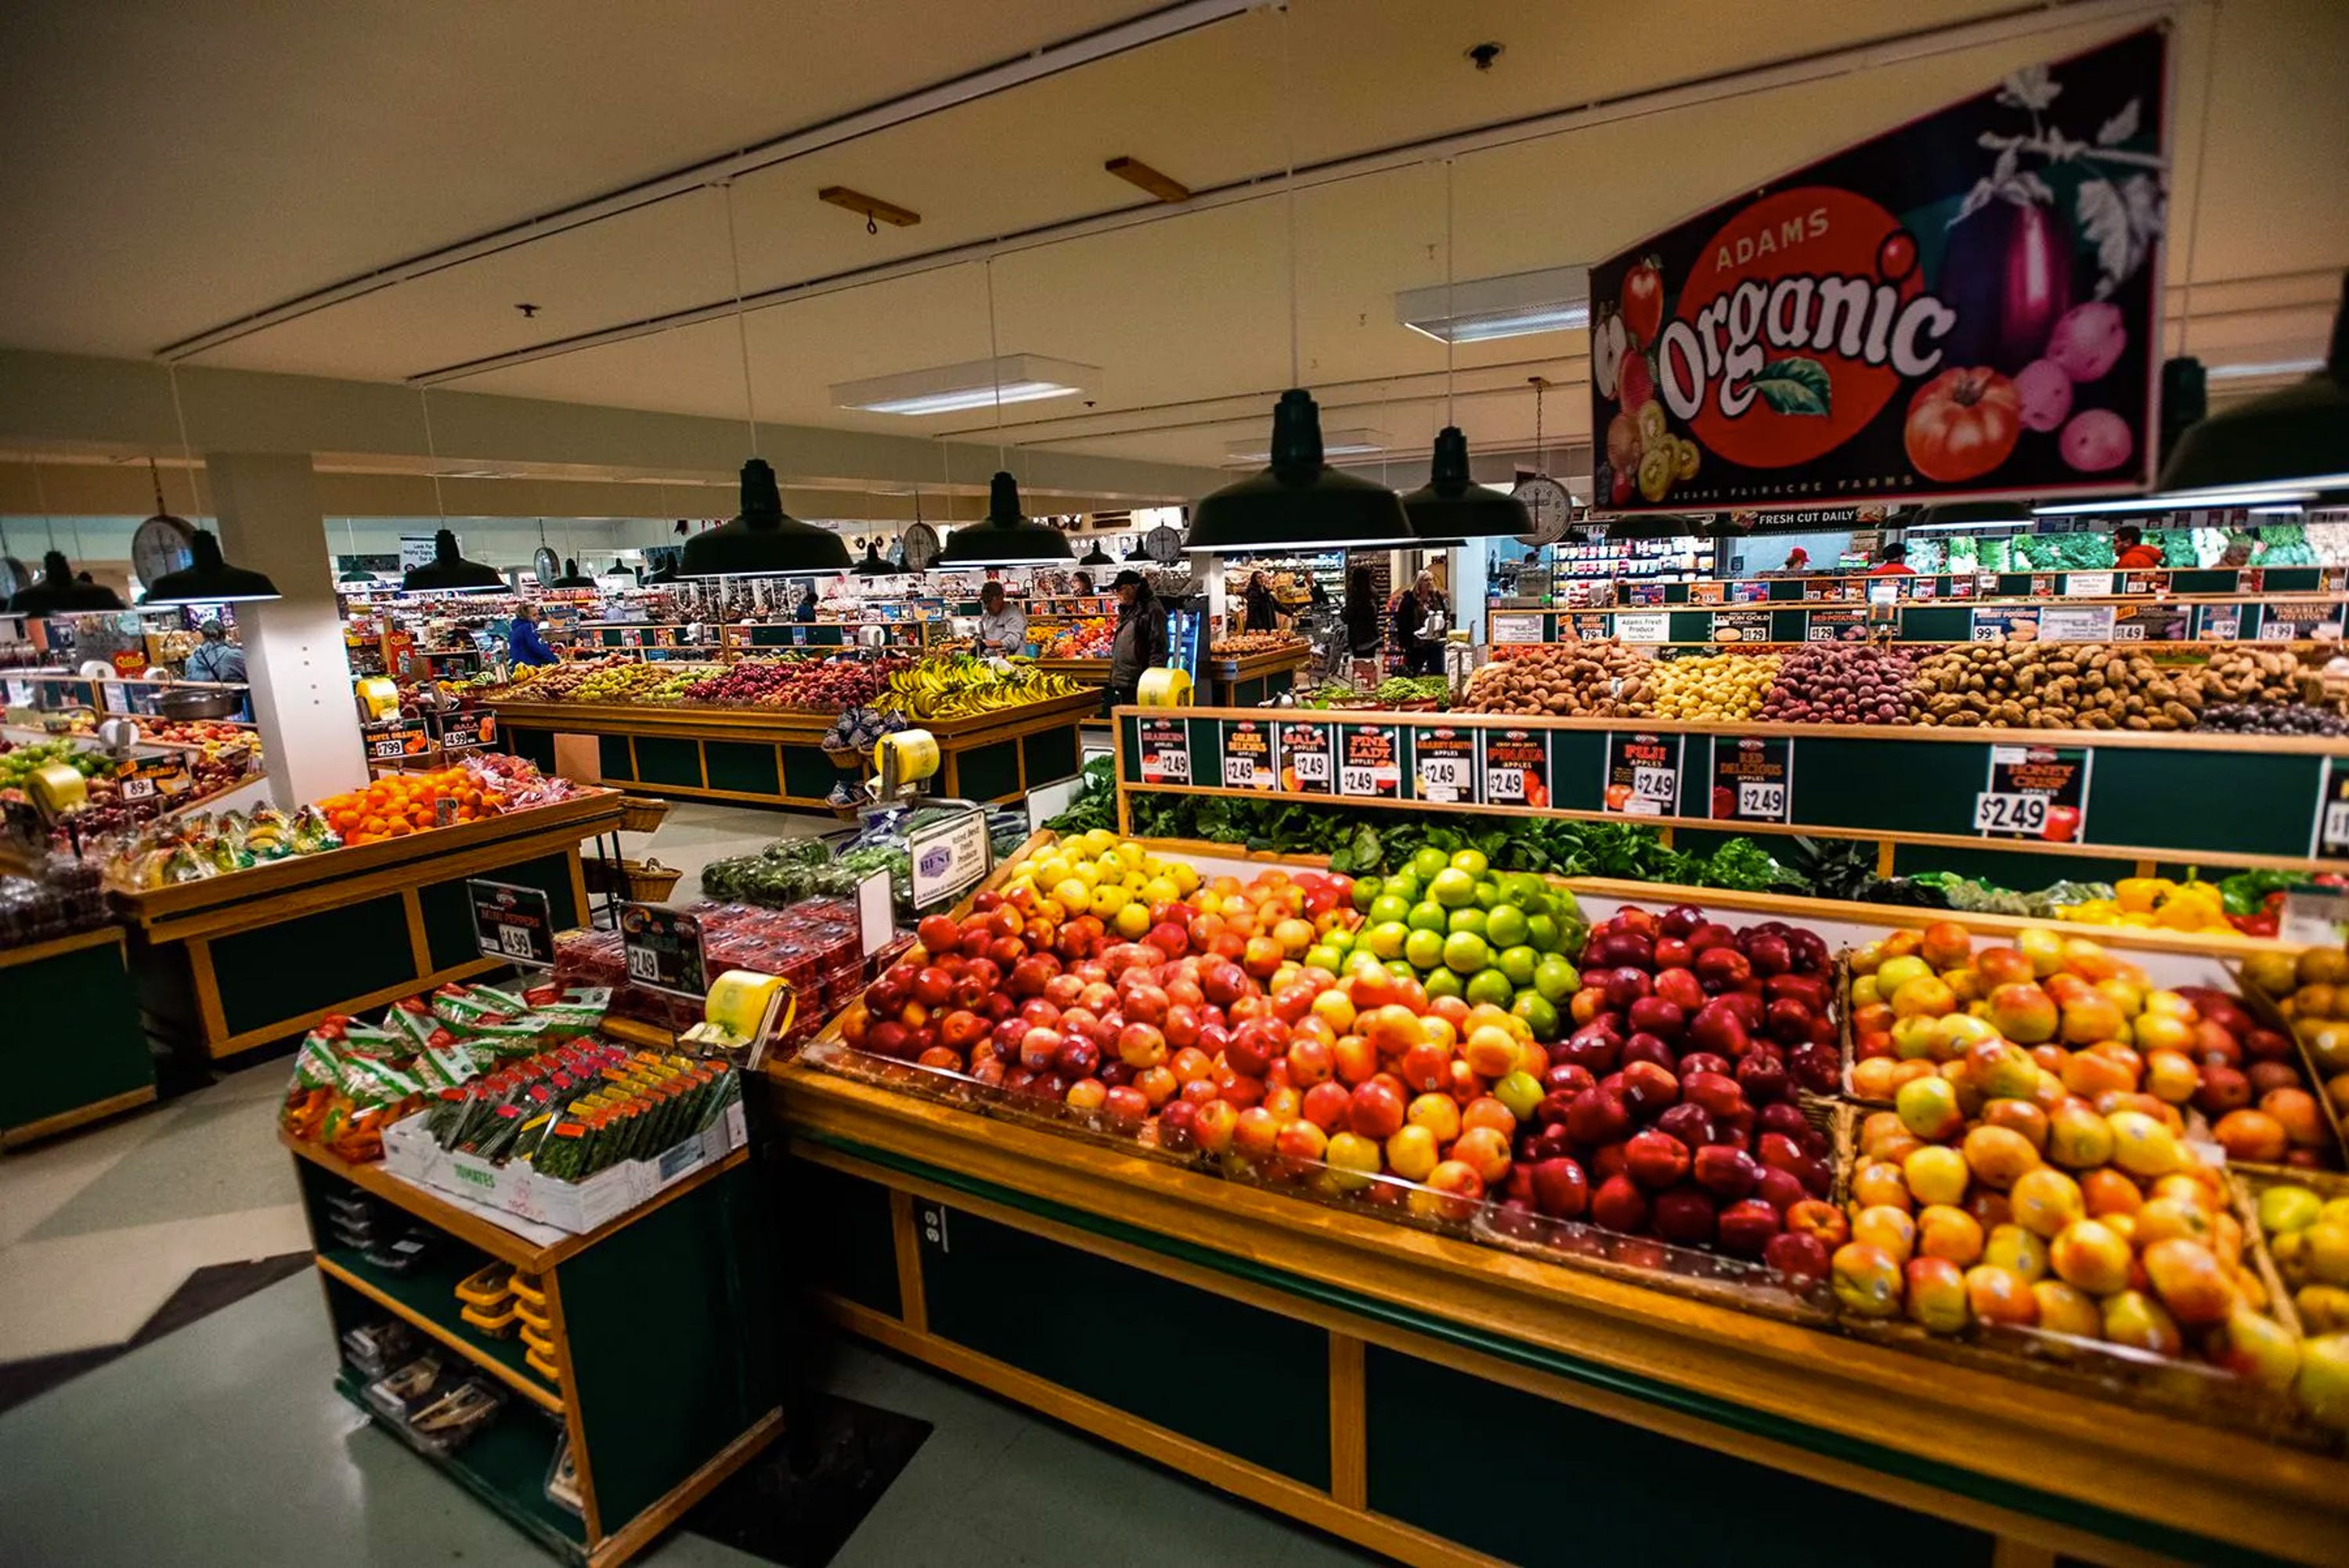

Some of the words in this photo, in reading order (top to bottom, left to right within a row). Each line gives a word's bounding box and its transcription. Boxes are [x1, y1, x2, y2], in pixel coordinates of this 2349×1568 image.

[1716, 207, 1830, 272] ADAMS
[1659, 276, 1957, 420] Organic
[1730, 481, 1822, 497] FAIRACRE
[1838, 475, 1914, 491] FARMS
[1759, 514, 1794, 525] FRESH
[1797, 512, 1820, 524] CUT
[1823, 510, 1854, 522] DAILY
[1282, 734, 1326, 745] GALA
[1350, 735, 1391, 747] PINK
[1349, 747, 1392, 759] LADY
[1625, 744, 1667, 760] FUJI
[1738, 752, 1765, 763] RED
[1719, 763, 1783, 776] DELICIOUS
[2008, 764, 2076, 777] HONEY
[2012, 776, 2069, 789] CRISP
